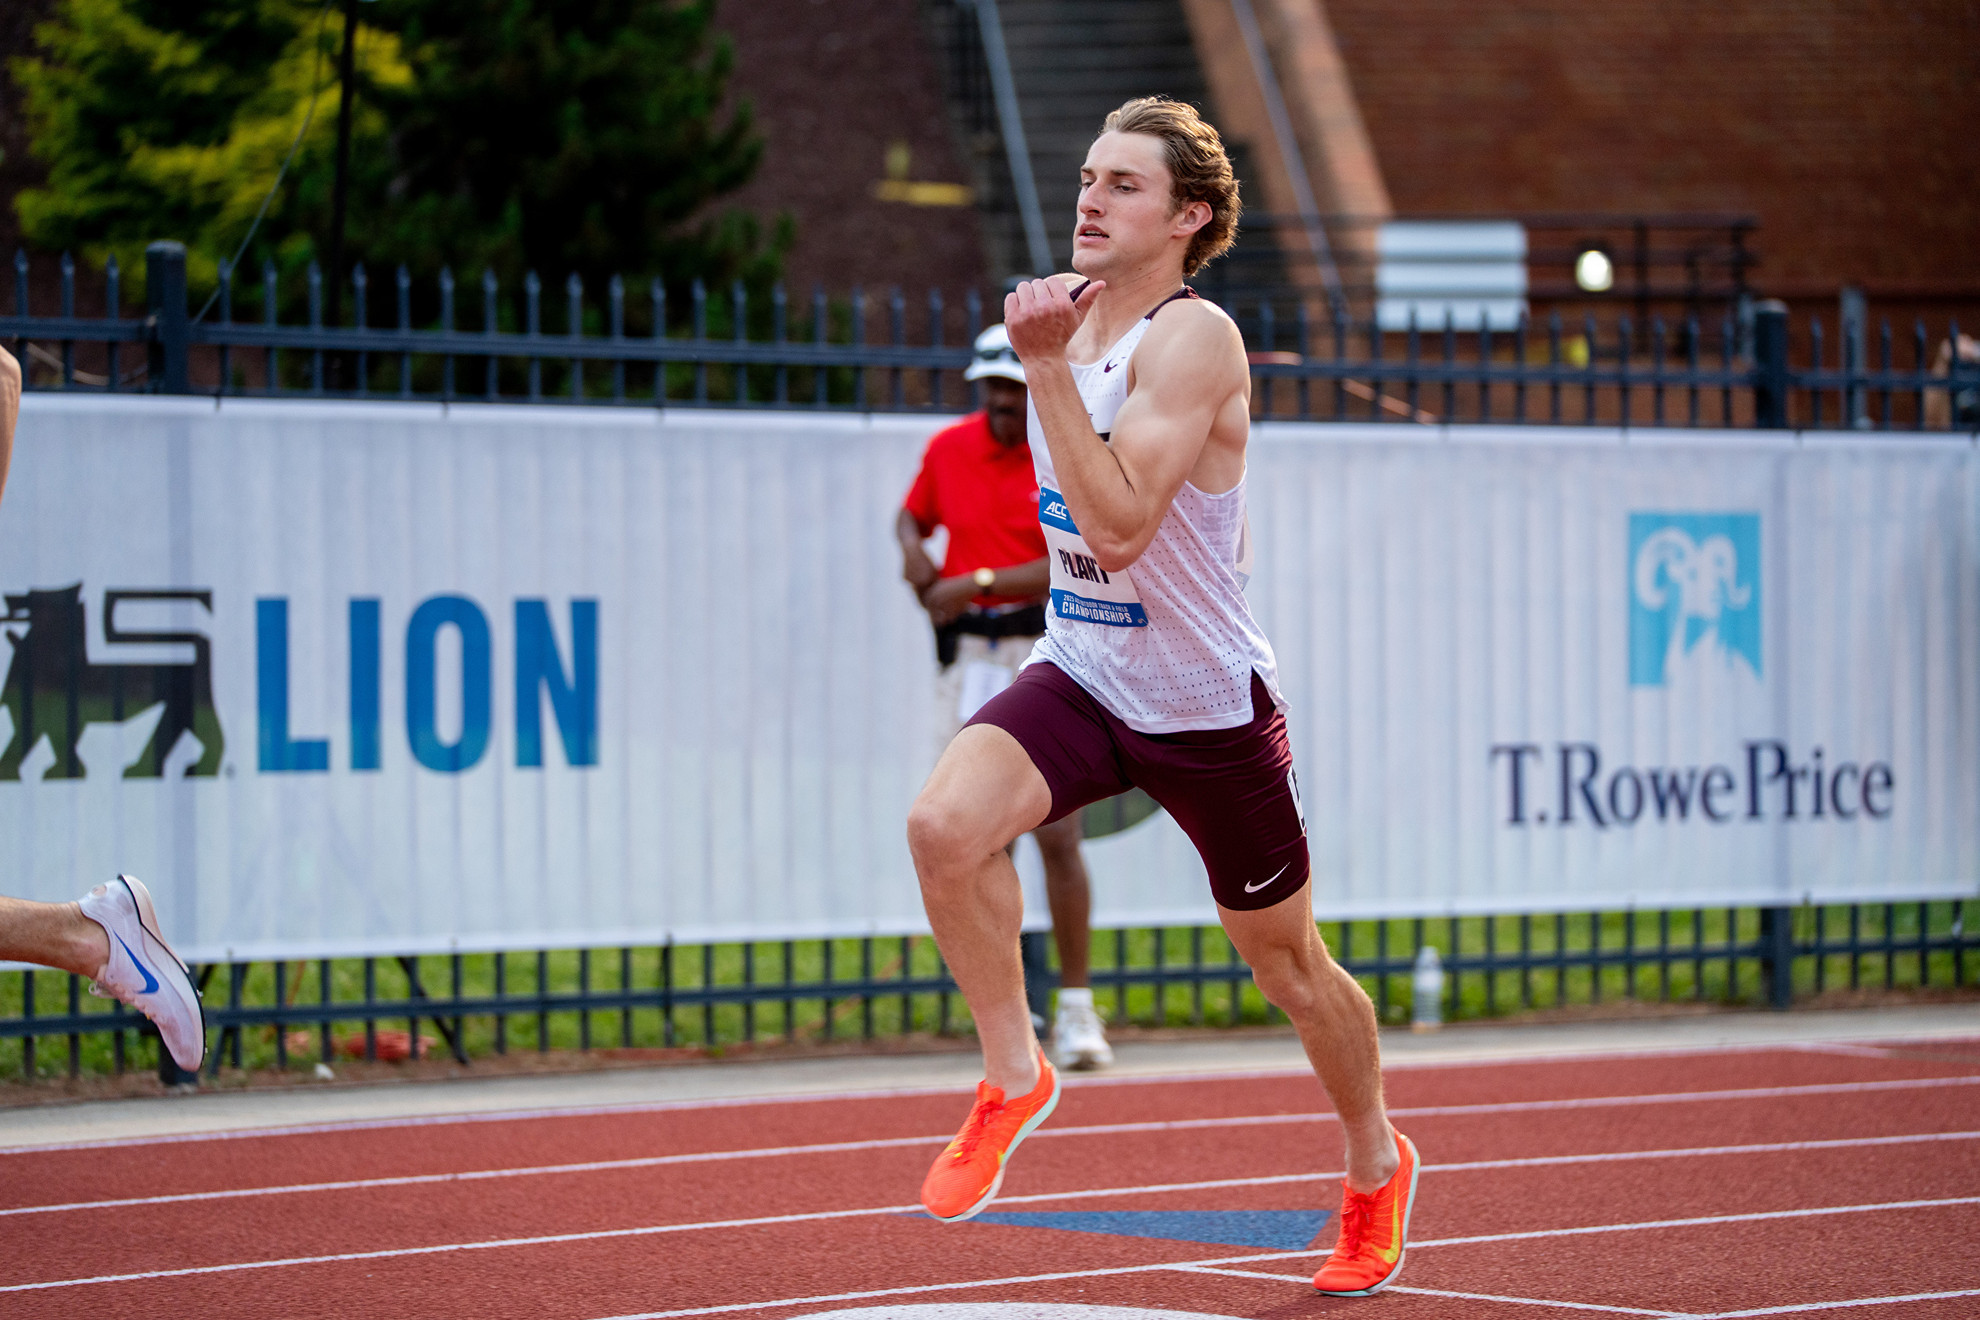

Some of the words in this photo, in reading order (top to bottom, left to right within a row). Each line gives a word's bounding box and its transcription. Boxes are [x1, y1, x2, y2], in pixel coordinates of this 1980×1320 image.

[1046, 501, 1067, 517] ACC
[1062, 601, 1133, 623] CHAMPIONSHIPS
[255, 593, 600, 774] LION
